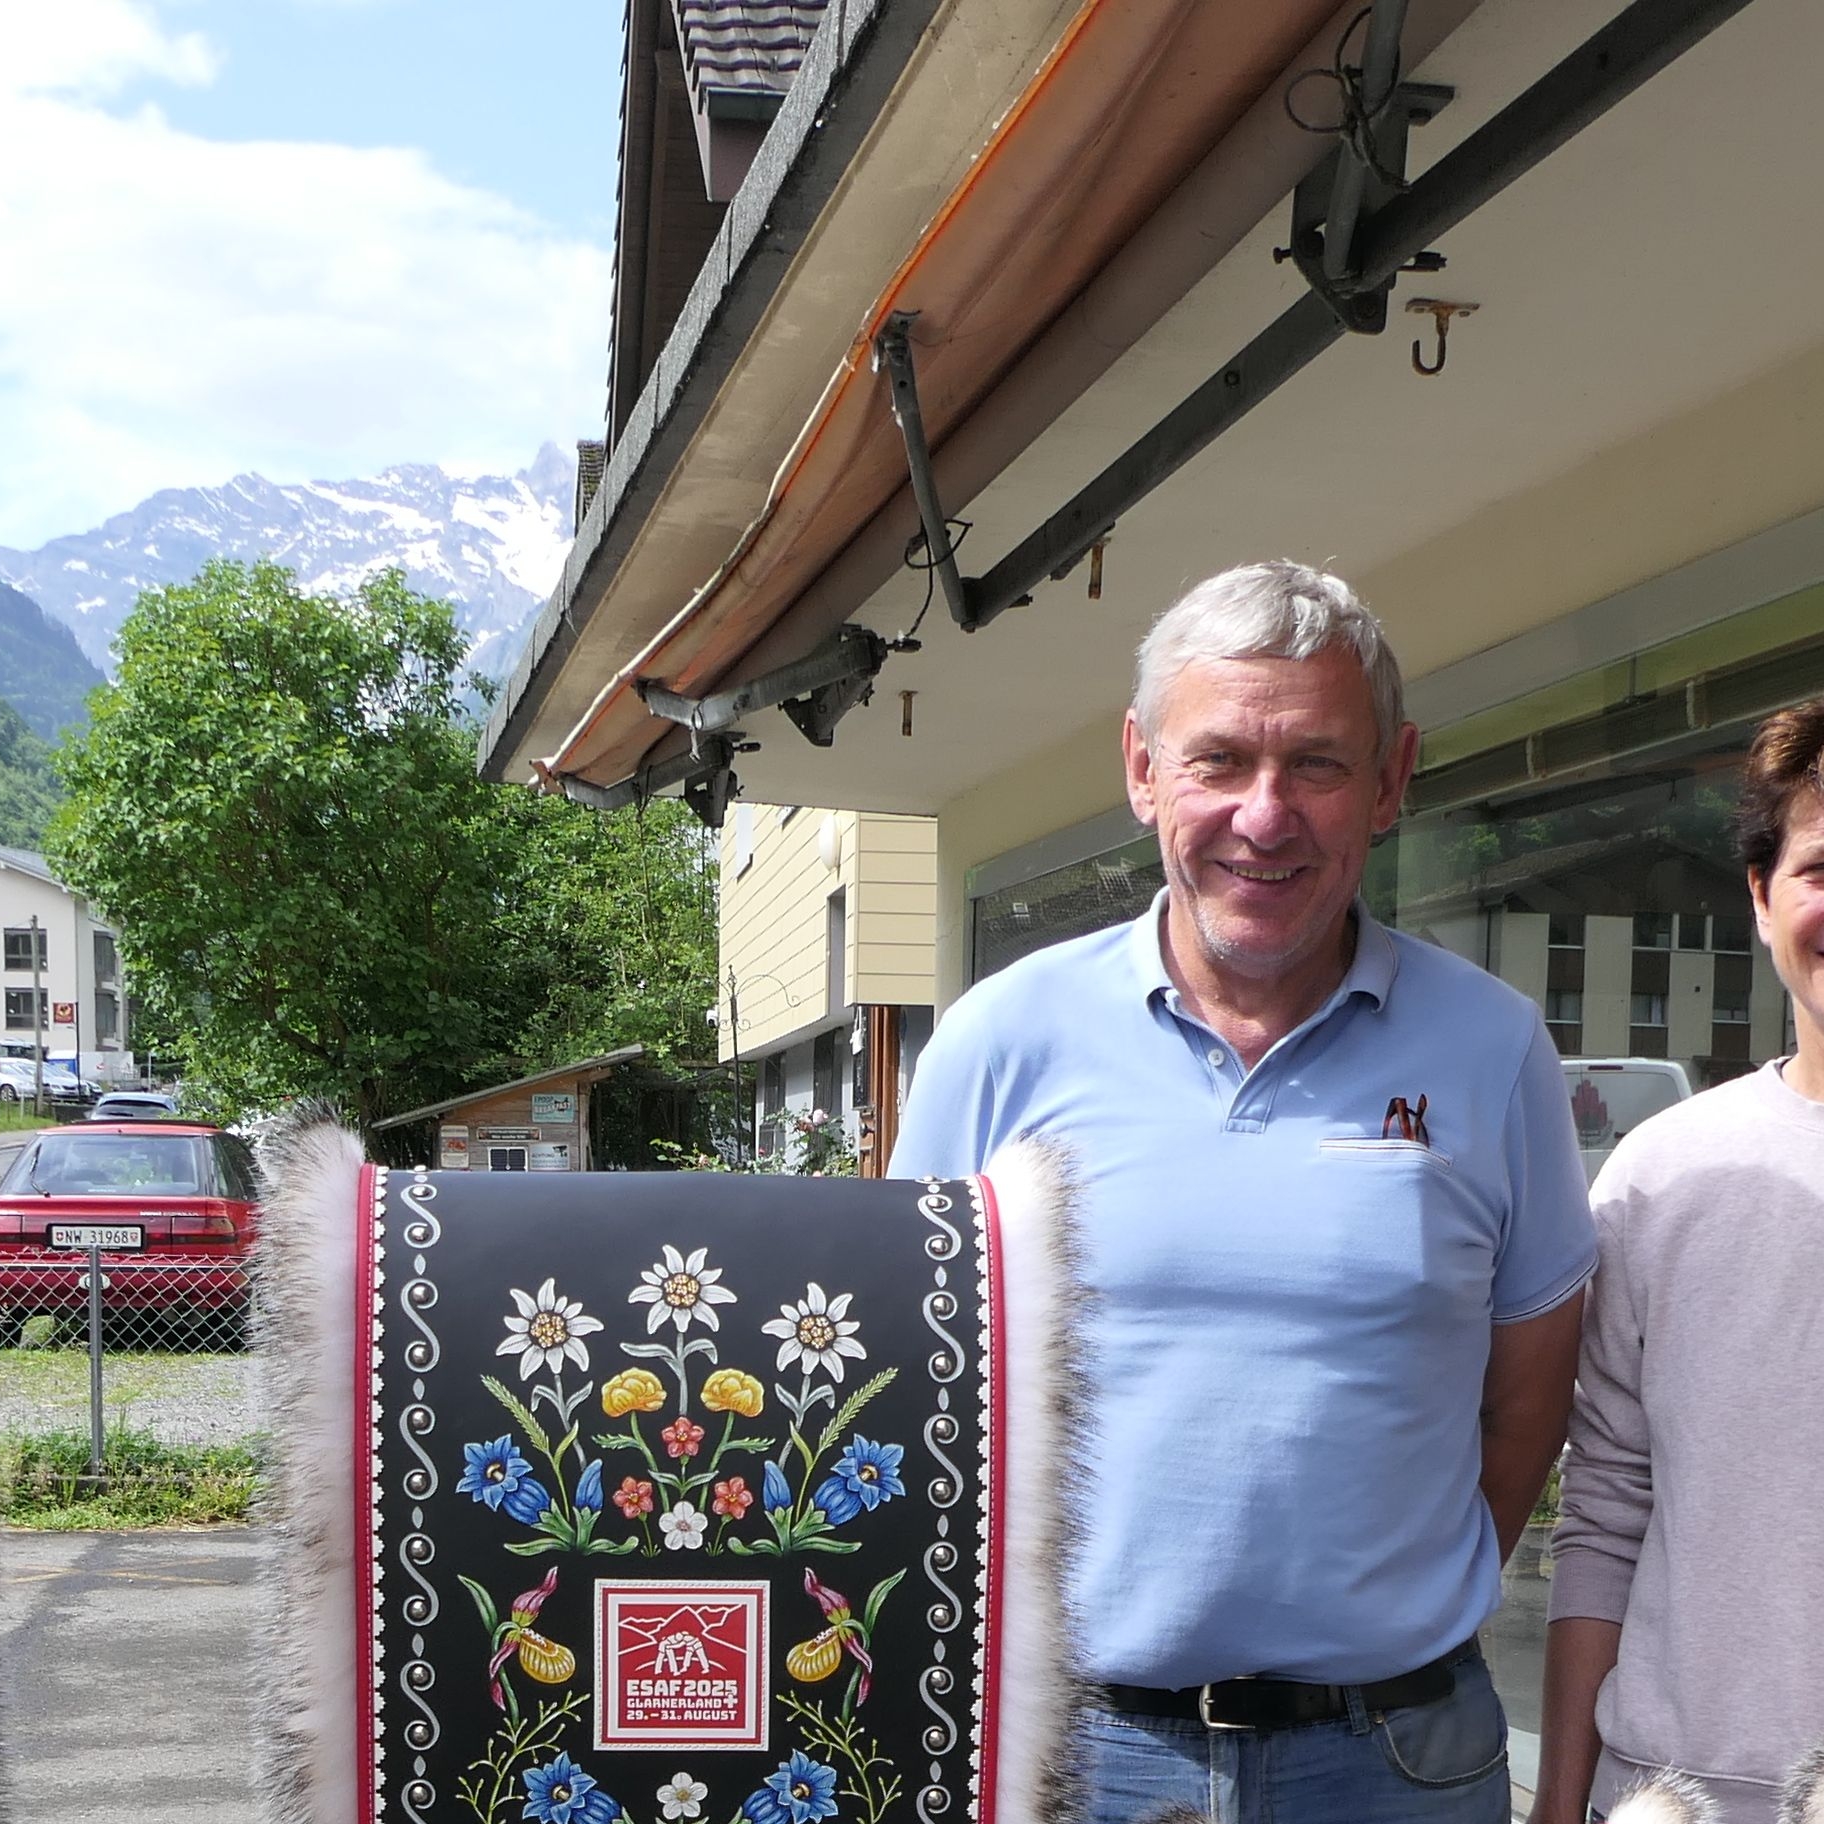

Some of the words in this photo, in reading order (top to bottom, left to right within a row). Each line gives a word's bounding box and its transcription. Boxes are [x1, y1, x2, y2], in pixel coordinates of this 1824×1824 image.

[90, 1230, 129, 1244] 31968
[627, 1679, 682, 1697] ESAF
[683, 1679, 738, 1697] 2025
[684, 1710, 738, 1720] AUGUST
